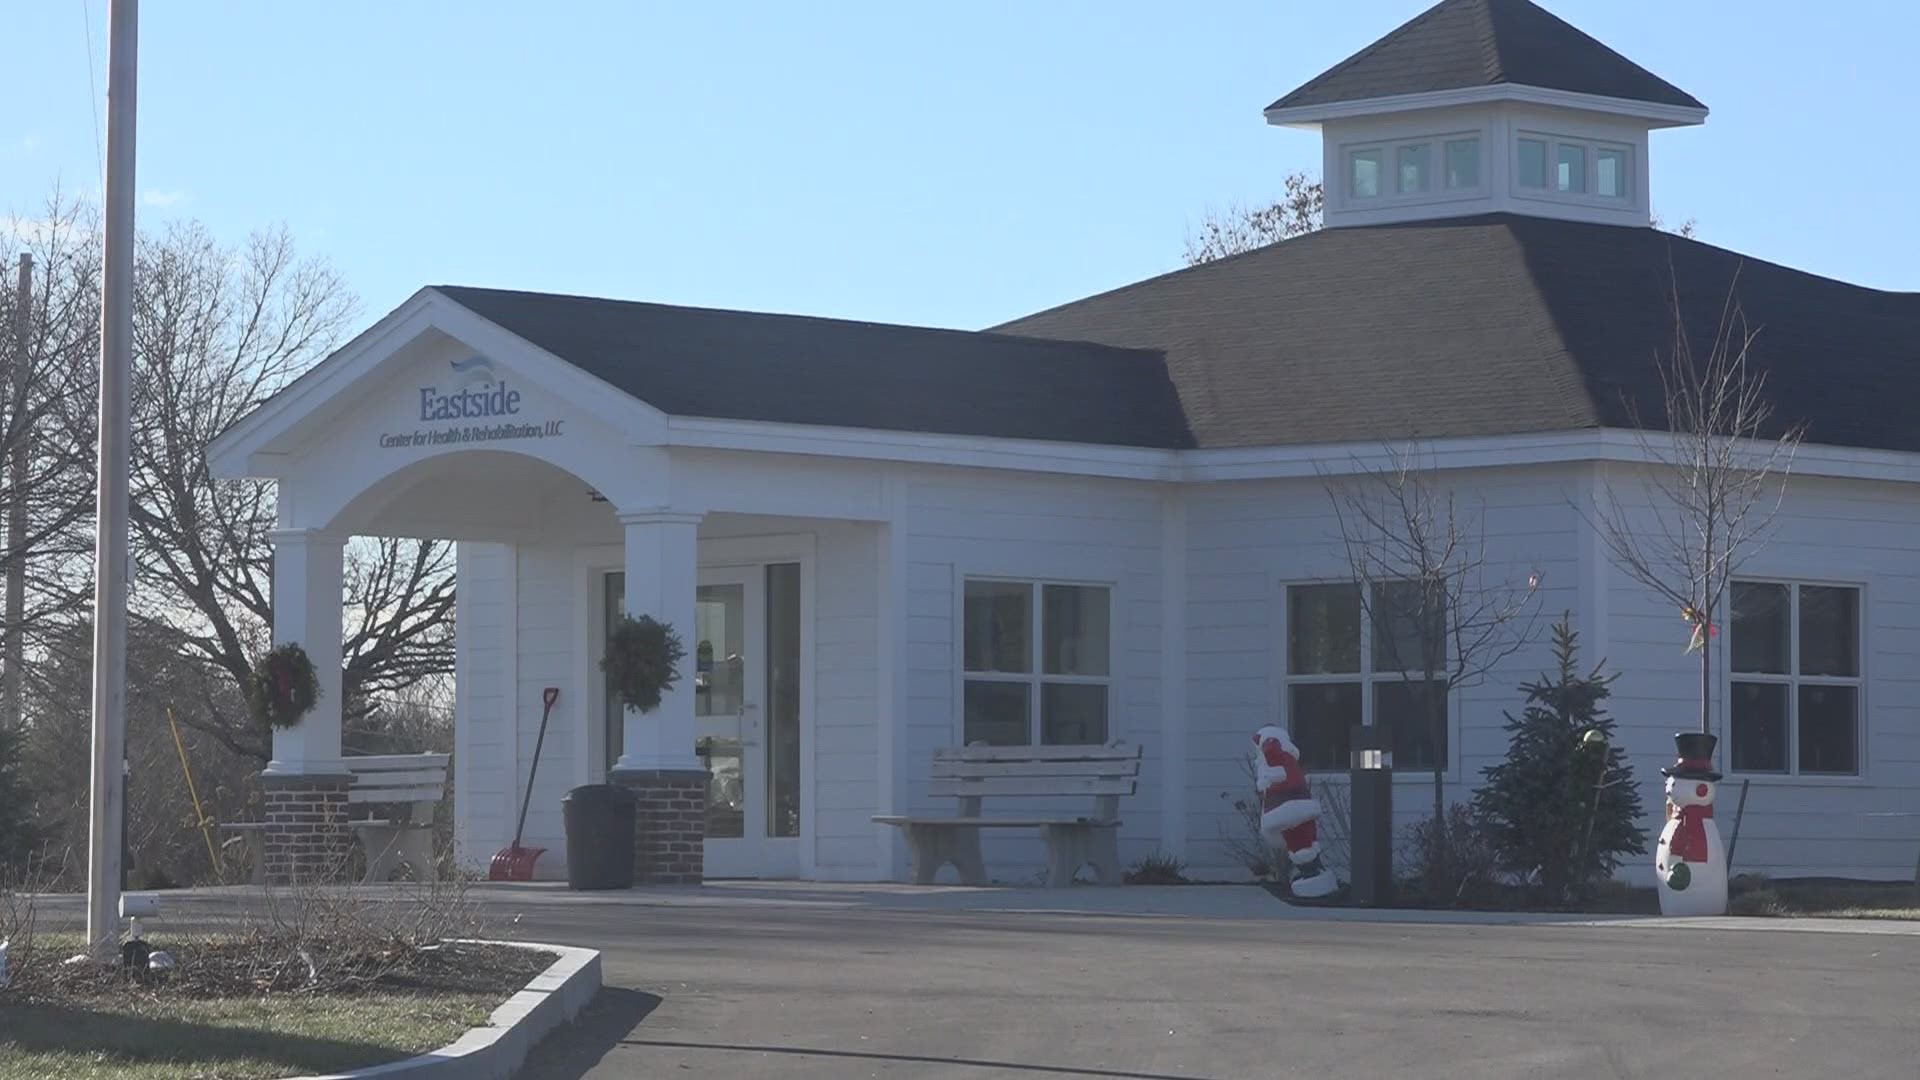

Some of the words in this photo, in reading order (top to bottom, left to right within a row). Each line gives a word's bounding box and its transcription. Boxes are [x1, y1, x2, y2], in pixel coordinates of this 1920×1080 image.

[420, 381, 520, 421] Eastside
[380, 431, 411, 448] Center
[413, 430, 426, 446] for
[428, 427, 461, 445] Health
[462, 427, 470, 442] &
[544, 420, 565, 437] LLC
